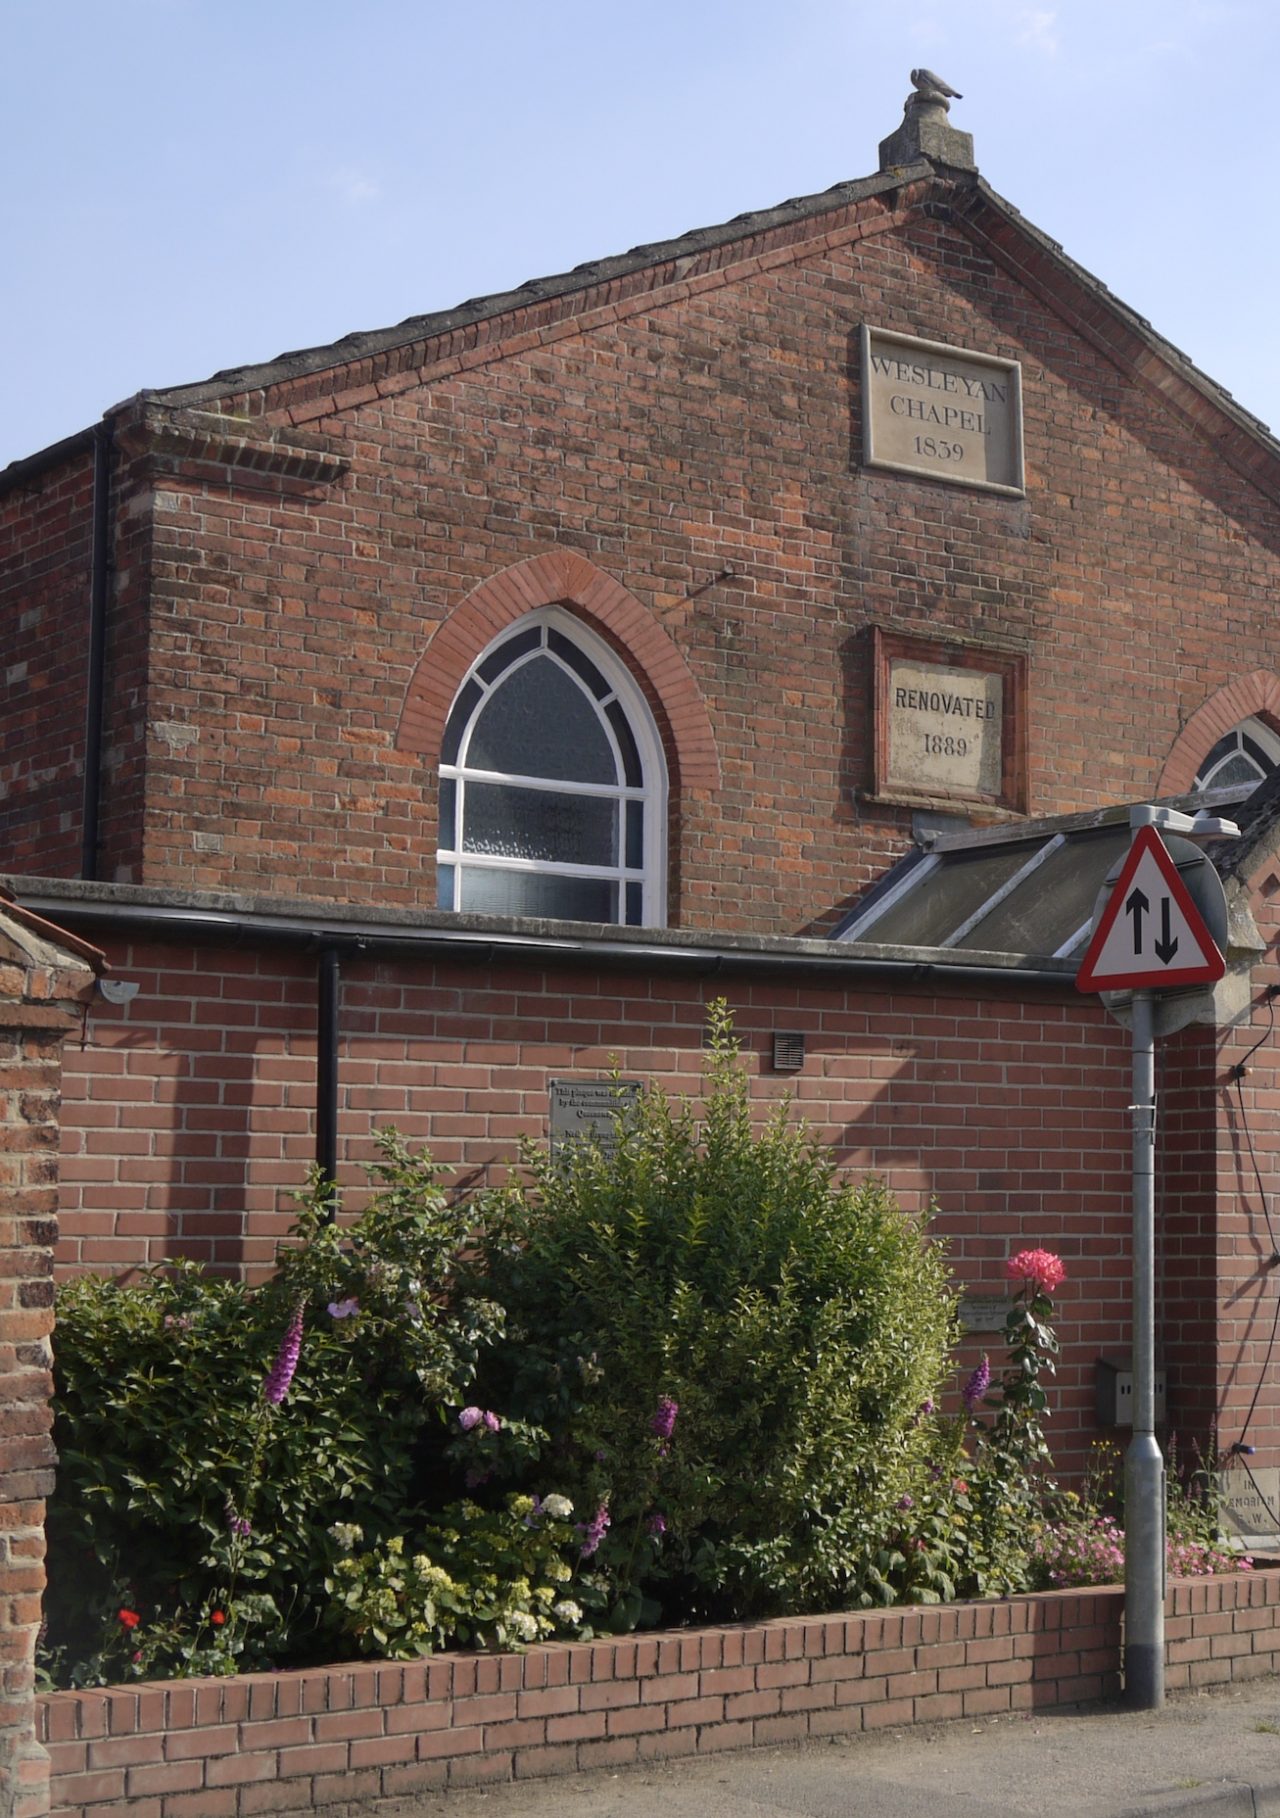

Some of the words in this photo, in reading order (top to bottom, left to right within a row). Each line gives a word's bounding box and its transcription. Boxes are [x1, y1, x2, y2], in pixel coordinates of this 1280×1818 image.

[870, 355, 1008, 403] WESLEYAN
[890, 395, 992, 435] CHAPEL
[895, 687, 995, 720] RENOVATED
[924, 734, 967, 757] 1889
[1244, 1479, 1256, 1490] IN
